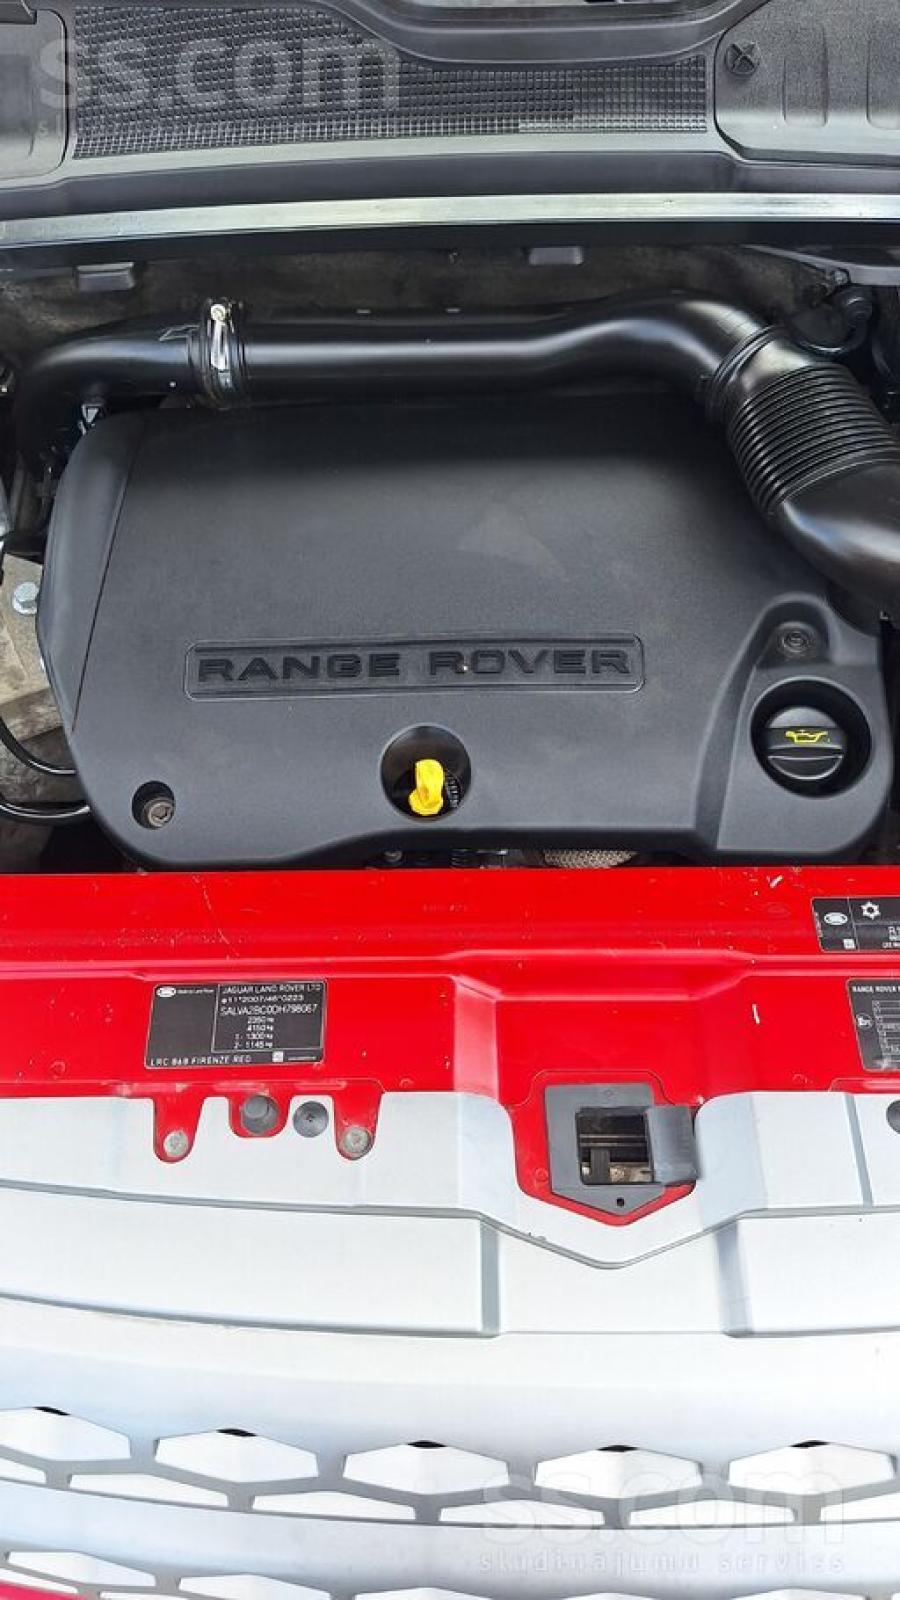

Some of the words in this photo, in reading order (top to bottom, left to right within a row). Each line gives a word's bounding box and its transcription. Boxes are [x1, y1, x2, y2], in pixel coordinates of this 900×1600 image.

[200, 654, 400, 681] RANGE
[429, 649, 631, 676] ROVER
[222, 985, 254, 994] JAGUAR
[255, 985, 278, 993] LAND
[279, 984, 305, 993] ROVER
[191, 1056, 230, 1065] FIRENZE
[232, 1054, 252, 1063] RED
